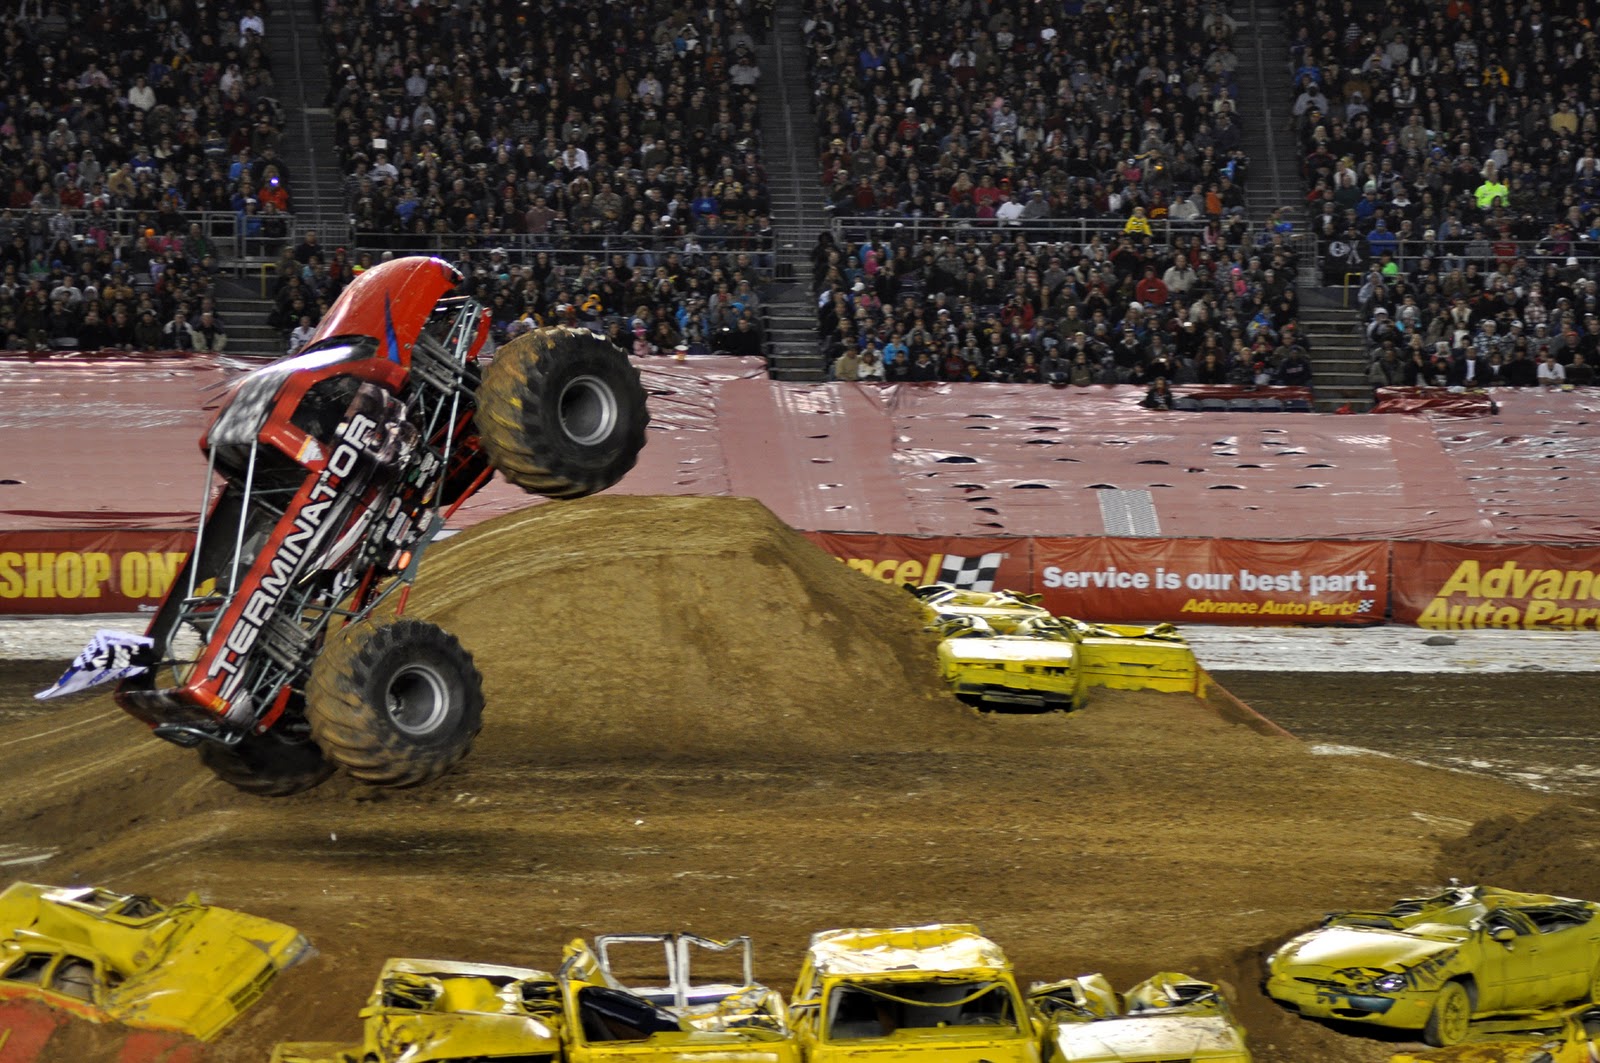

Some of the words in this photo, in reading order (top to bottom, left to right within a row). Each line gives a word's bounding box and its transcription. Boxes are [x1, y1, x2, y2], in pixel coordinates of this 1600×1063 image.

[208, 413, 377, 677] TERMINATOR
[0, 551, 111, 599] SHOP
[120, 551, 187, 599] ON
[1042, 566, 1150, 589] Service
[1156, 567, 1182, 590] is
[1186, 572, 1233, 591] our
[1239, 569, 1303, 592] best
[1181, 598, 1257, 614] Advance
[1258, 600, 1308, 615] Auto
[1307, 601, 1359, 616] Parts
[1416, 598, 1519, 627] Auto
[1522, 600, 1600, 627] Par
